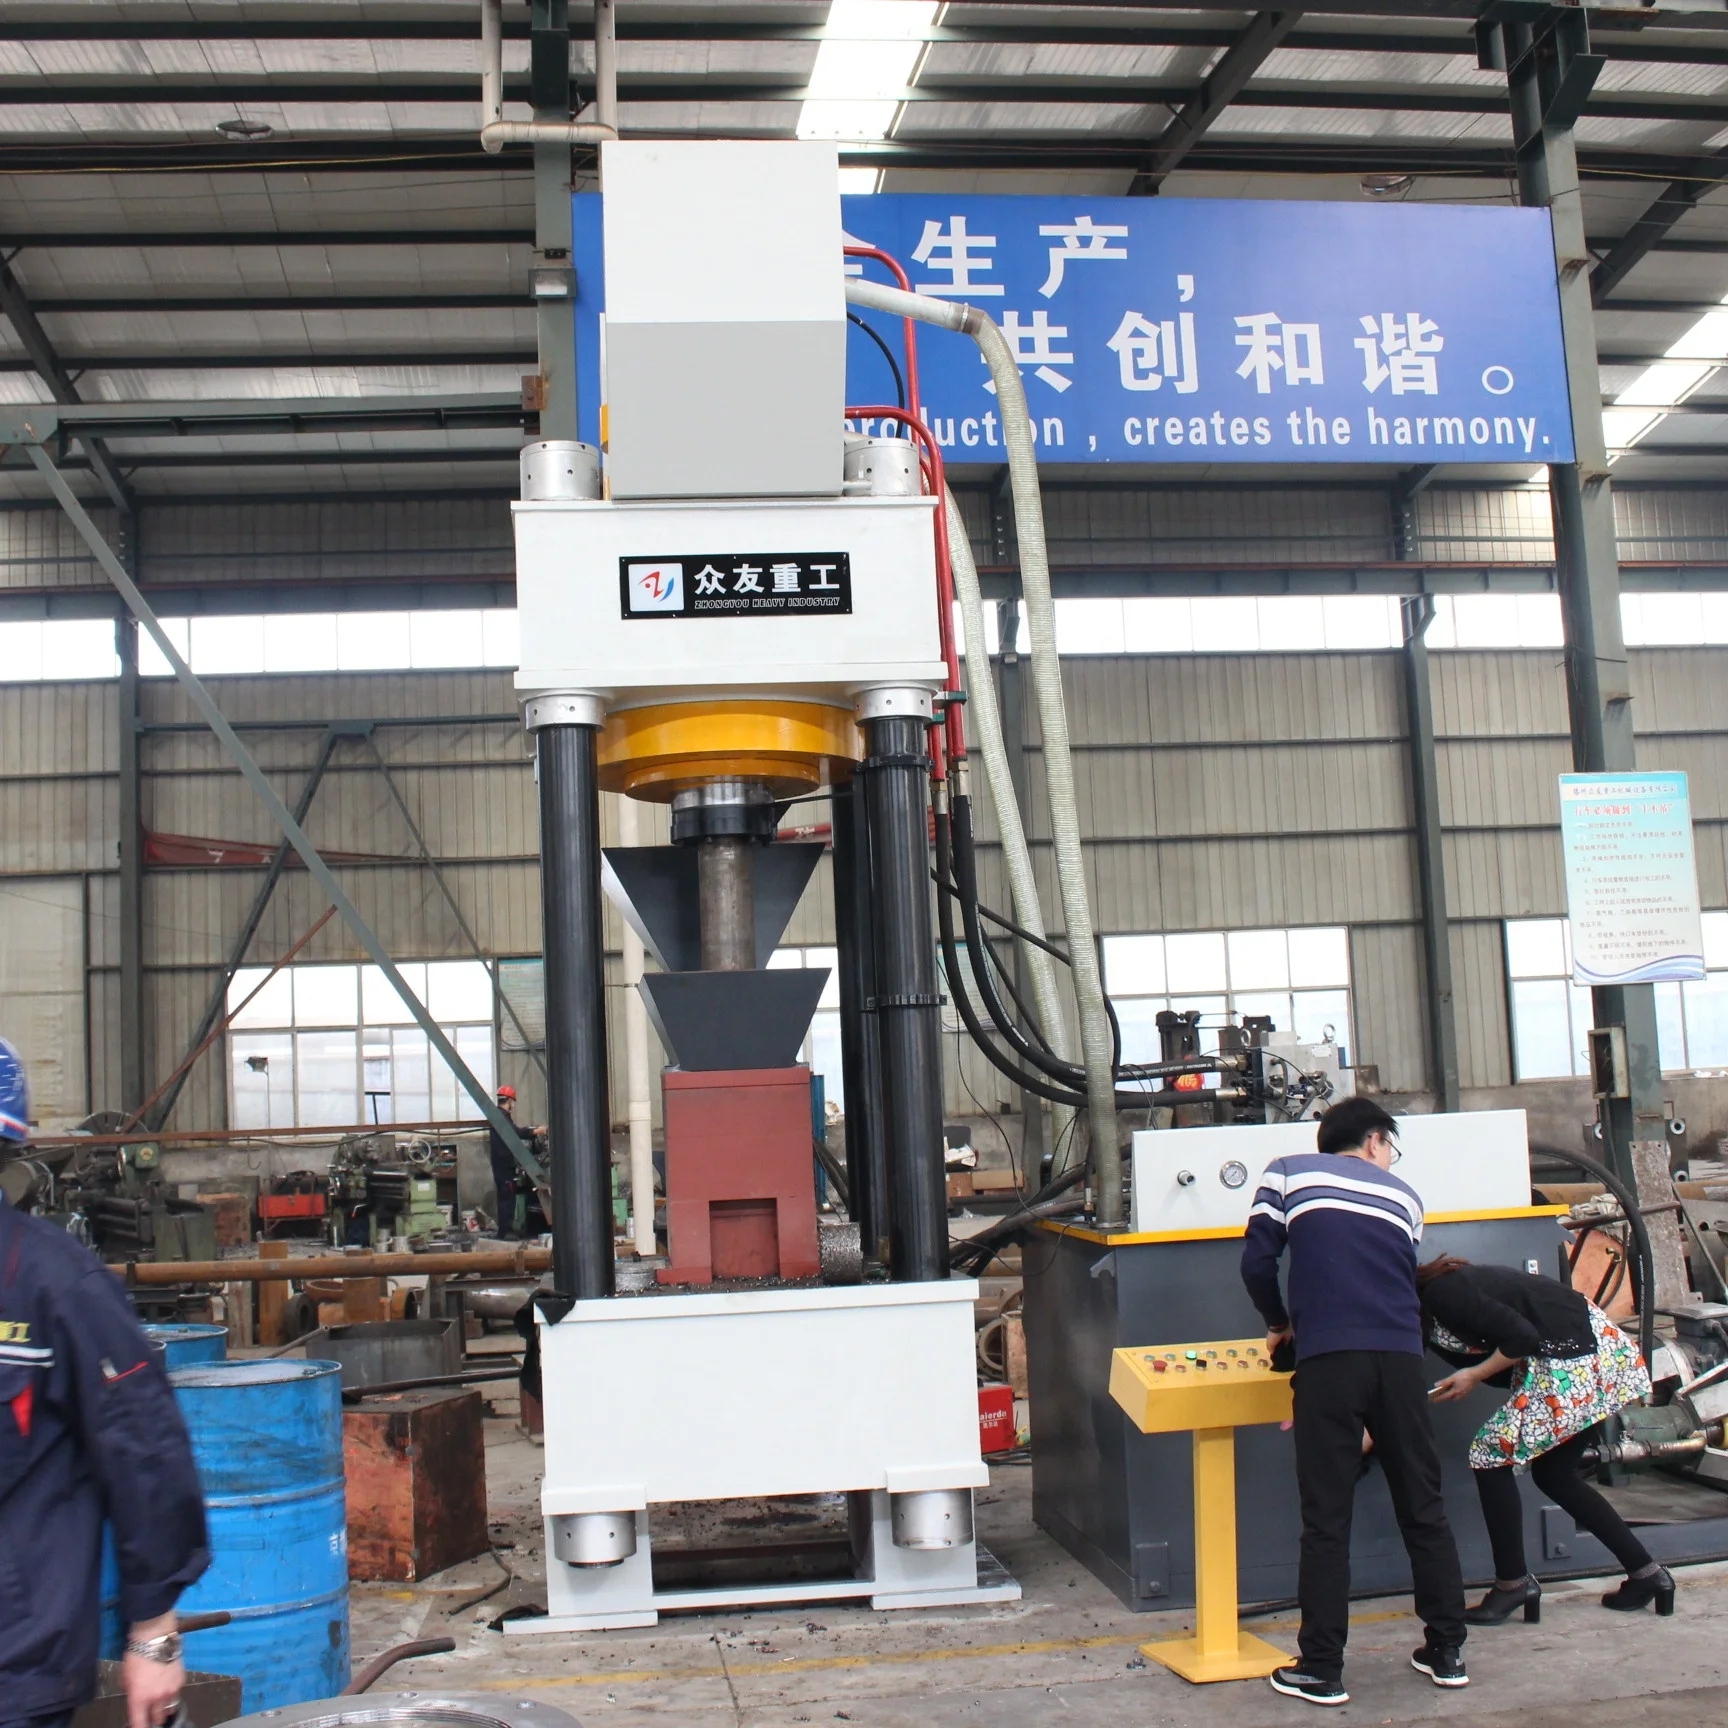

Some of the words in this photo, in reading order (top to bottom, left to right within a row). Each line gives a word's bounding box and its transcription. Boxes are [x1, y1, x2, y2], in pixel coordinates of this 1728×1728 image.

[1124, 410, 1272, 446] creates
[1286, 406, 1351, 446] the
[1367, 406, 1551, 453] harmony.
[693, 562, 841, 596] 众友重工
[694, 599, 750, 610] ZHONGYOU
[752, 598, 786, 608] HEAVY
[787, 596, 841, 607] INDUSTRY
